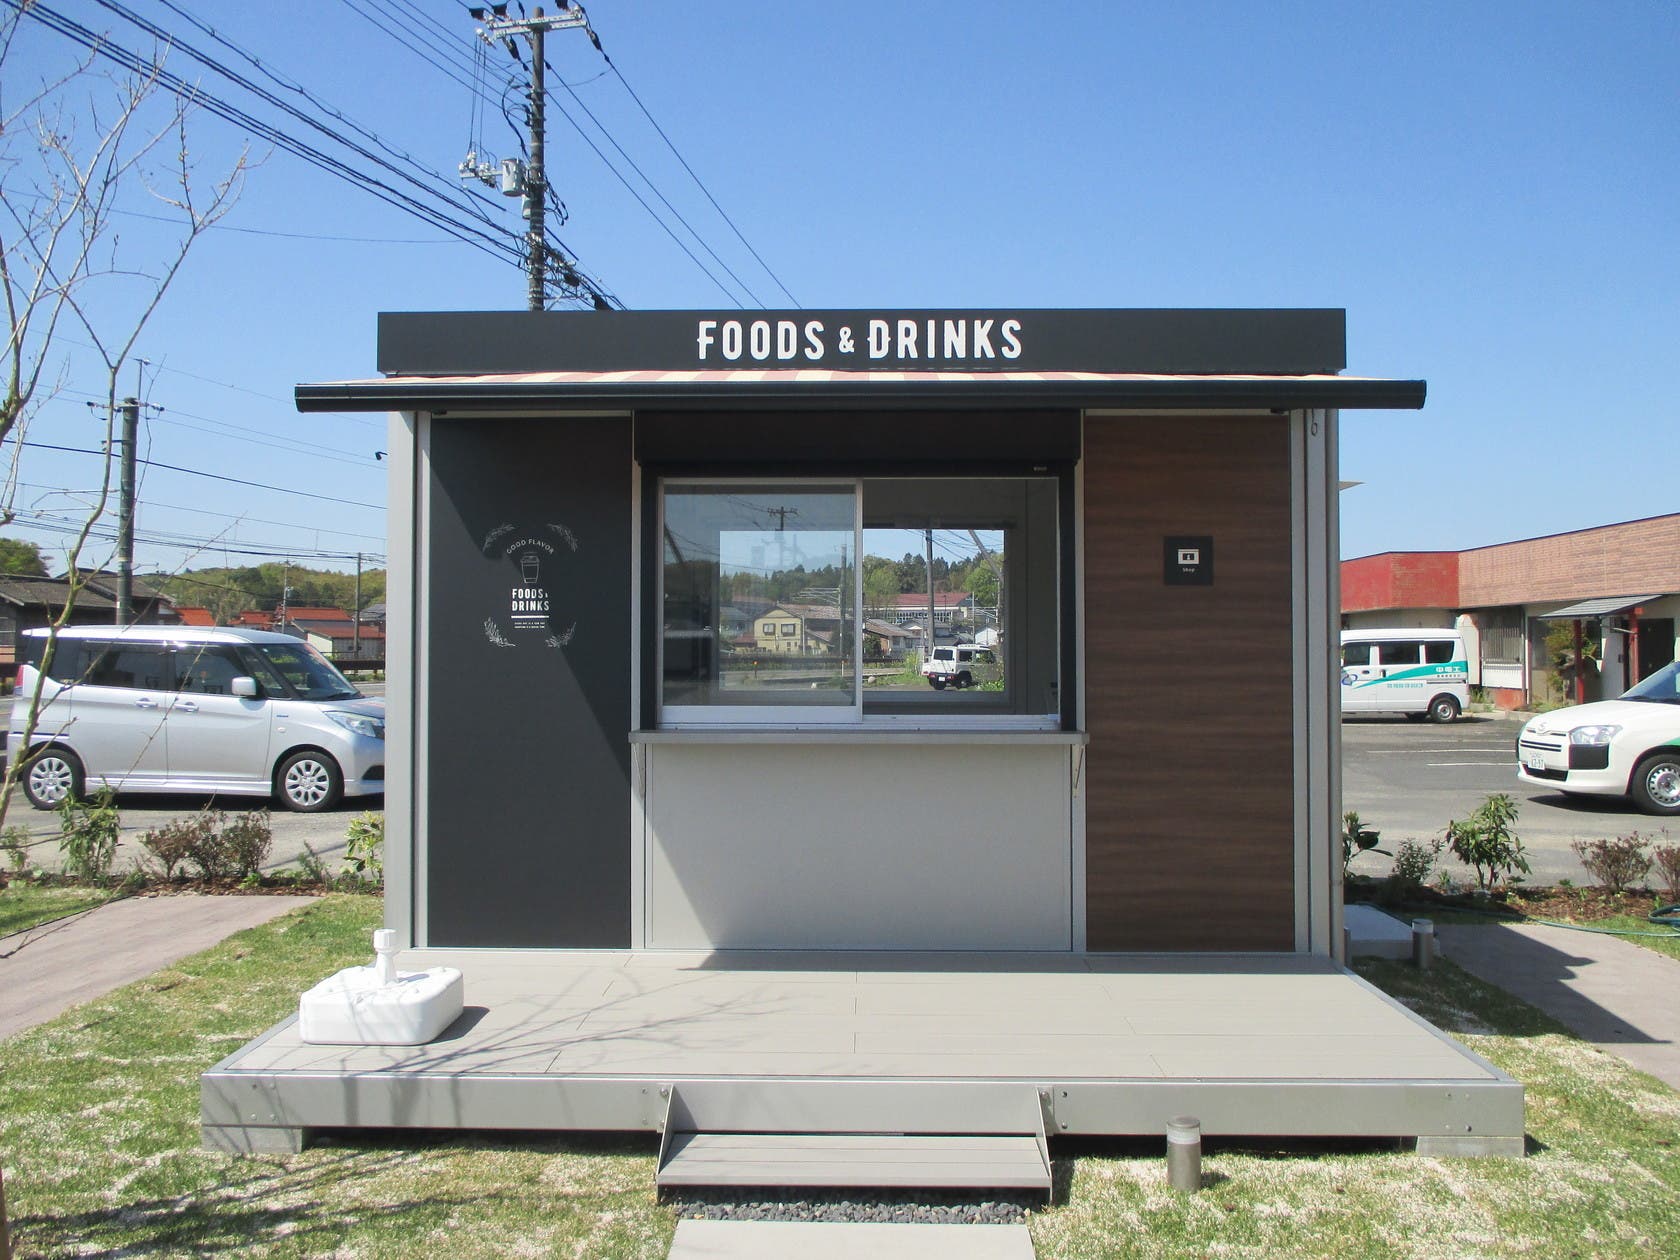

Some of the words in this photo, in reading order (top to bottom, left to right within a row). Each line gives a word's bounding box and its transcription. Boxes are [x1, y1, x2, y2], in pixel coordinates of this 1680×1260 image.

[697, 320, 825, 360] FOODS
[838, 326, 856, 353] &
[867, 319, 1022, 359] DRINKS
[506, 539, 526, 554] GOOD
[528, 538, 554, 554] FLAVOR
[511, 588, 544, 599] FOODS
[511, 600, 550, 611] DRINKS
